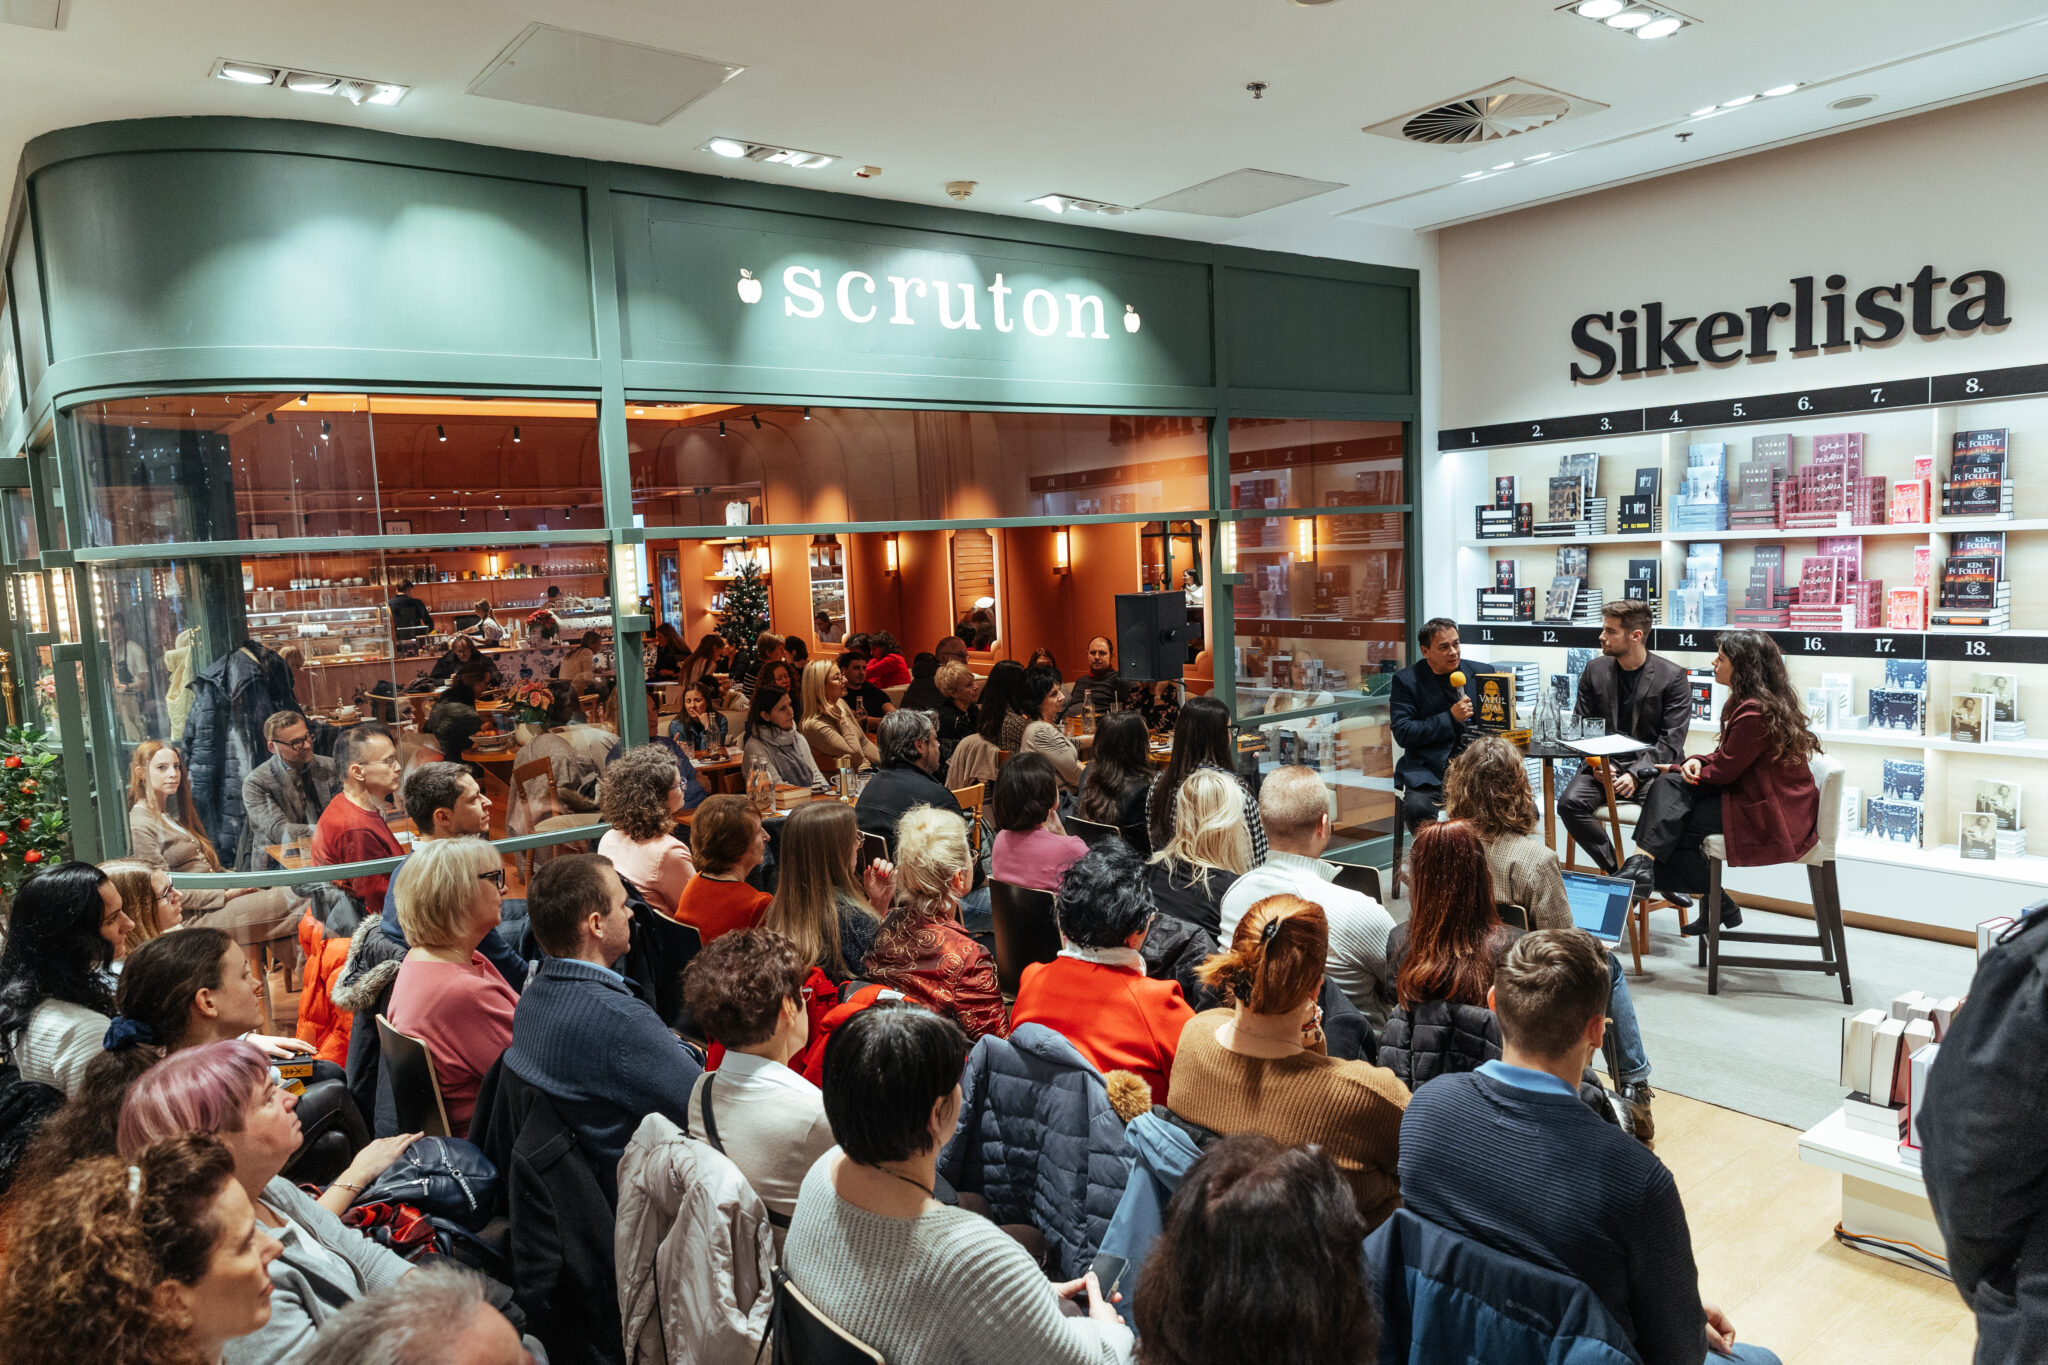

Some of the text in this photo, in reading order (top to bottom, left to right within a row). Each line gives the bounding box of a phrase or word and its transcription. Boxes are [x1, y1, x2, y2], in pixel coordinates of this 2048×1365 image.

[783, 265, 1110, 340] scruton
[1571, 265, 2013, 381] Sikerlista
[1470, 378, 1984, 443] 1. 2. 3. 4. 5. 6. 7. 8.
[1969, 439, 2002, 448] FOLLETT
[1964, 472, 1998, 480] FOLLETT
[1967, 541, 1999, 549] FOLLETT
[1958, 567, 1991, 575] FOLLETT
[1482, 629, 1991, 656] 11. 12. 14. 16. 17. 18.
